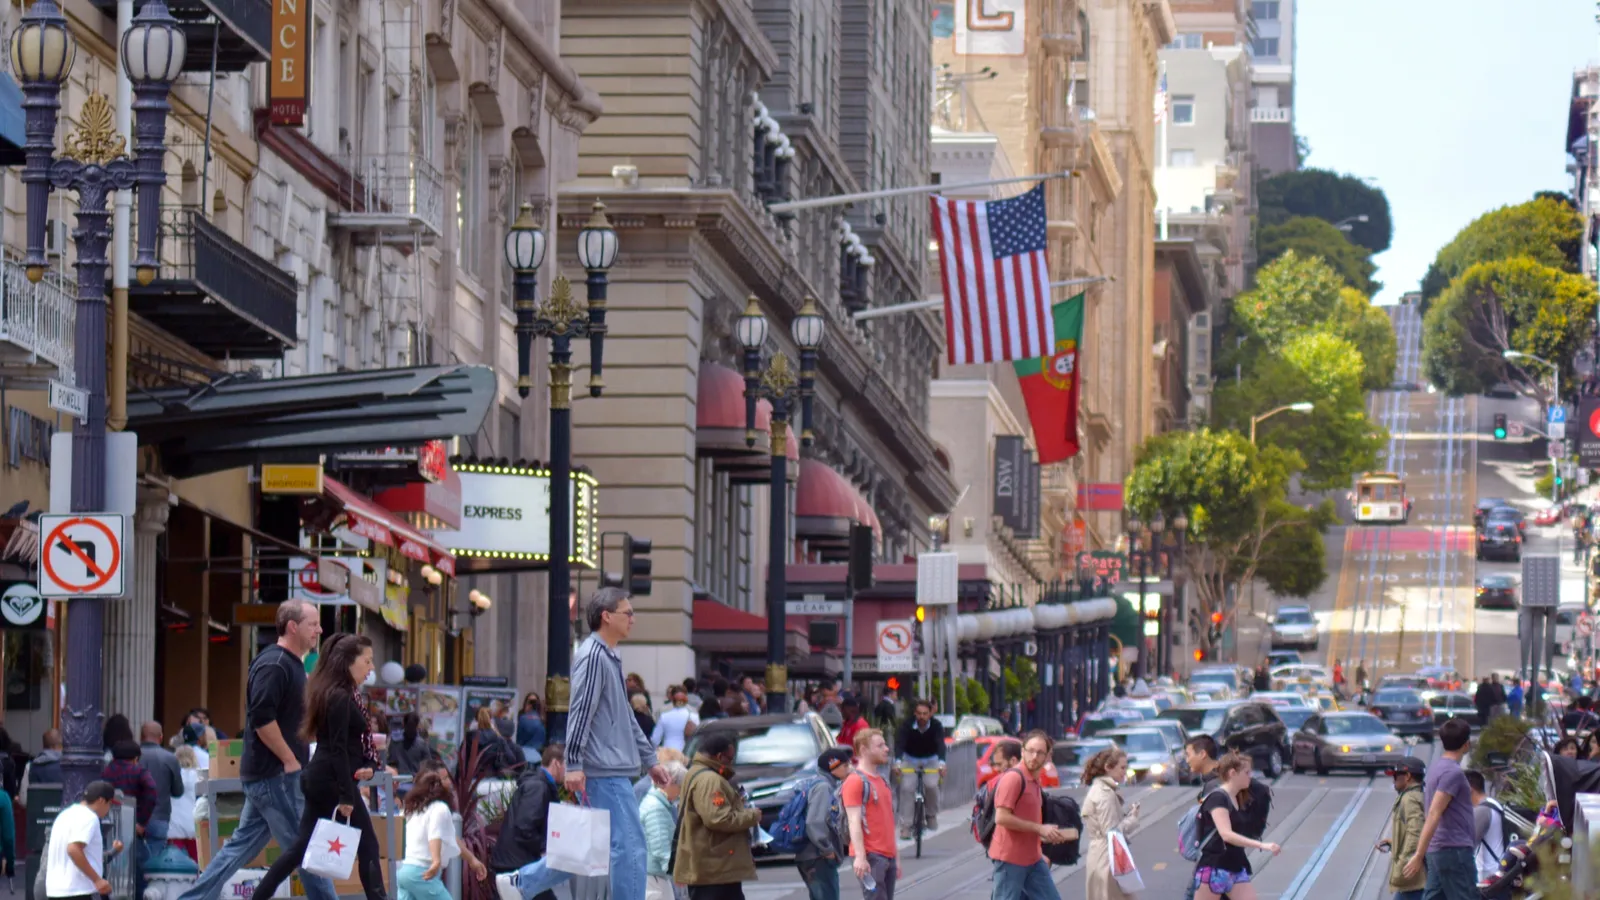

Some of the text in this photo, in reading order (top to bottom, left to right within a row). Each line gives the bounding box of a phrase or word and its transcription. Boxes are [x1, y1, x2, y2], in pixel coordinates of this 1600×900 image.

[272, 104, 301, 114] HOTEL
[57, 388, 81, 411] POWELL
[997, 457, 1013, 497] DSW
[463, 505, 522, 520] EXPRESS
[795, 603, 832, 613] GEARY
